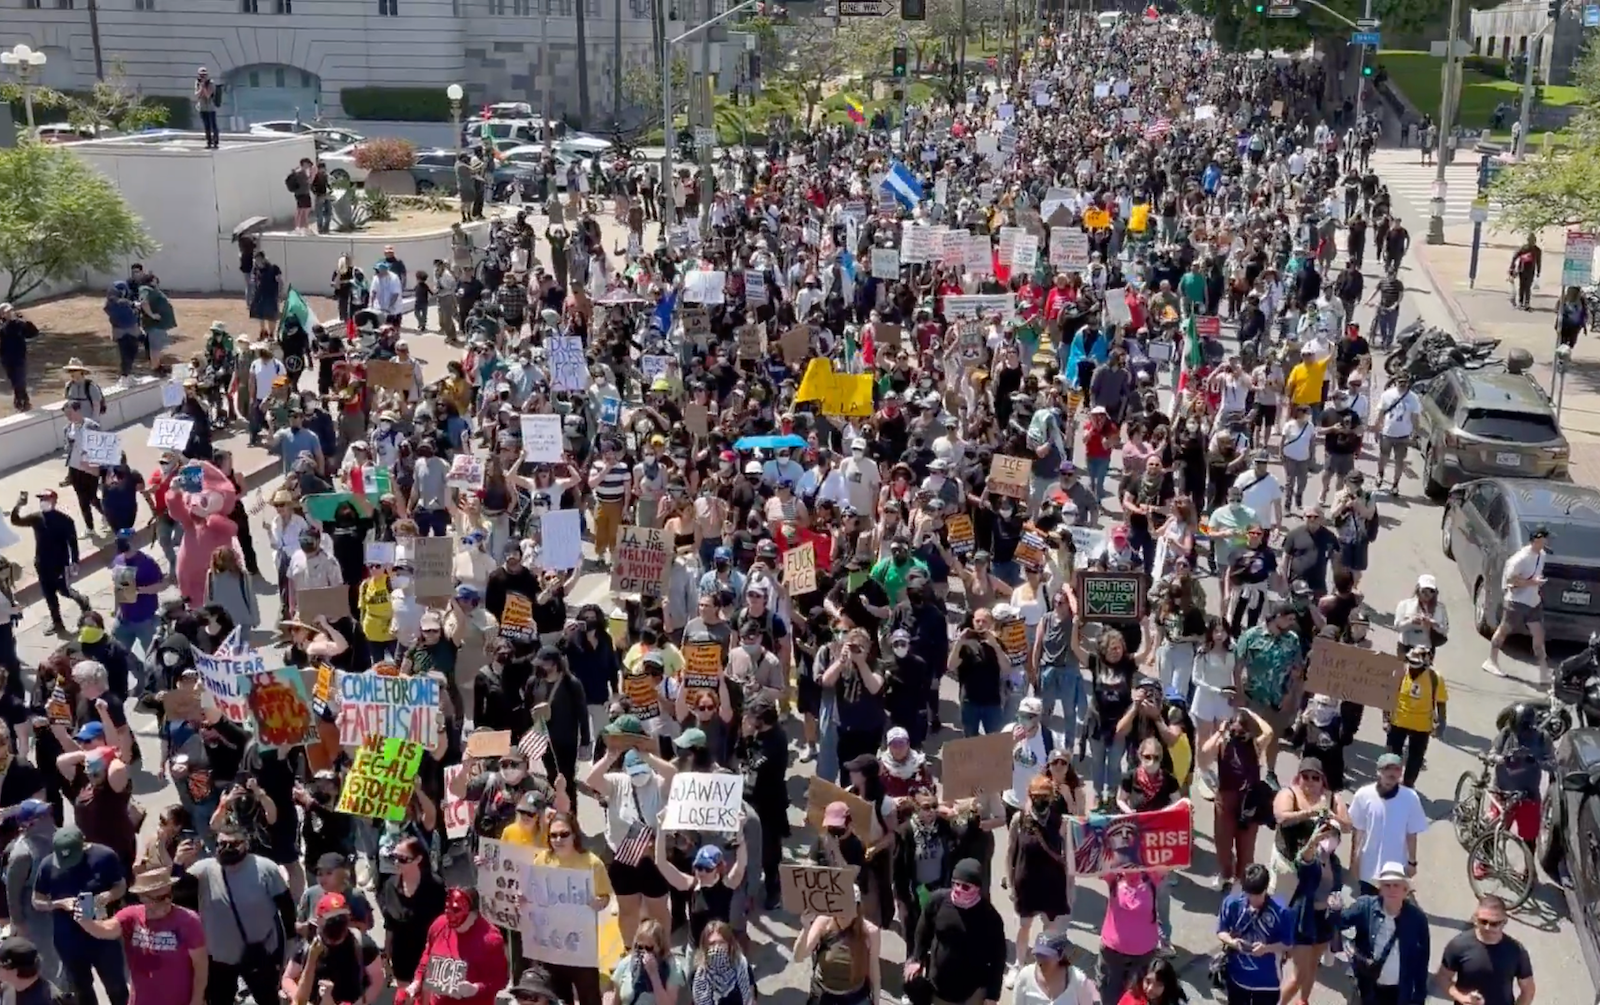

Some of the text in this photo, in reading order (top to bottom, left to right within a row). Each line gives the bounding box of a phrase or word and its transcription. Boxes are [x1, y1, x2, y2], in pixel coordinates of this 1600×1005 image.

[842, 3, 880, 12] ONE WAY
[551, 336, 581, 351] DUE
[1001, 457, 1023, 471] ICE
[621, 527, 660, 546] LA IS
[646, 540, 664, 551] THE
[619, 548, 666, 564] MELTING
[788, 546, 813, 571] FUCK
[629, 562, 663, 579] POINT
[620, 578, 662, 595] OF ICE
[791, 570, 812, 591] ICE
[1088, 581, 1135, 592] THEN THEY
[1087, 591, 1134, 601] CAME FOR
[221, 657, 265, 674] TEAR
[342, 674, 439, 706] COME FOR ONE
[341, 703, 386, 741] FACE
[386, 705, 410, 738] US
[410, 707, 437, 748] ALL
[397, 743, 417, 760] IS
[352, 755, 412, 783] EGAL
[350, 776, 412, 807] STOLEN
[678, 805, 737, 828] LOSERS
[1145, 831, 1188, 847] RISE
[1146, 849, 1173, 865] UP
[792, 867, 845, 895] FUCK
[802, 890, 844, 913] ICE
[425, 956, 467, 992] ICE
